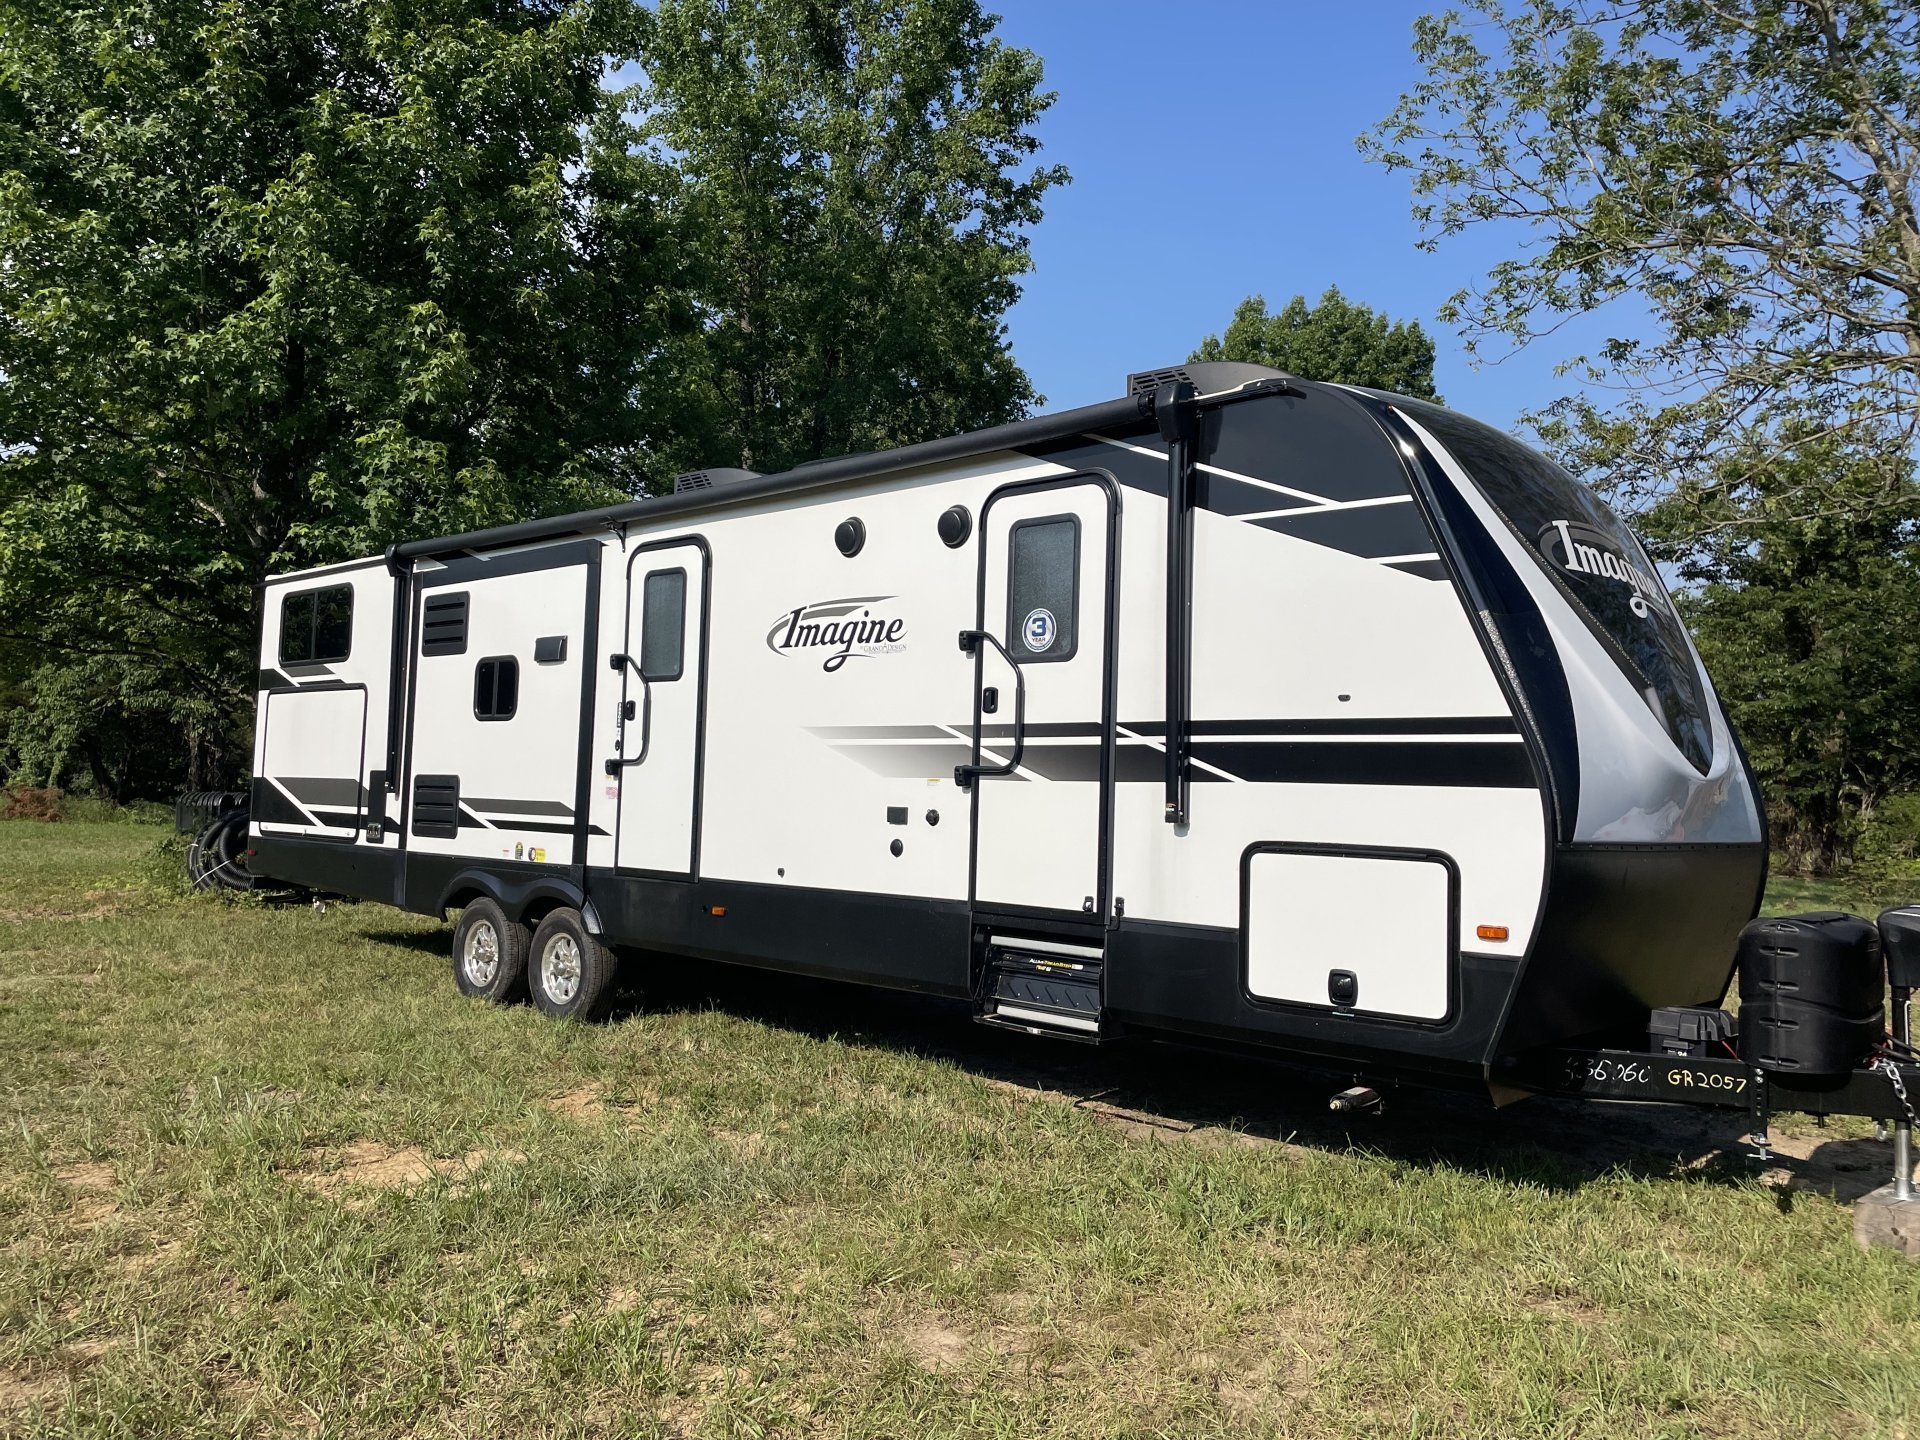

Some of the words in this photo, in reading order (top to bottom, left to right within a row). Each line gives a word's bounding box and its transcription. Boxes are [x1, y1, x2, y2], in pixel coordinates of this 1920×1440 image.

[1552, 519, 1665, 618] Imagine
[778, 605, 908, 672] Imagine
[1031, 617, 1047, 637] 3
[1667, 1069, 1747, 1094] GR2057
